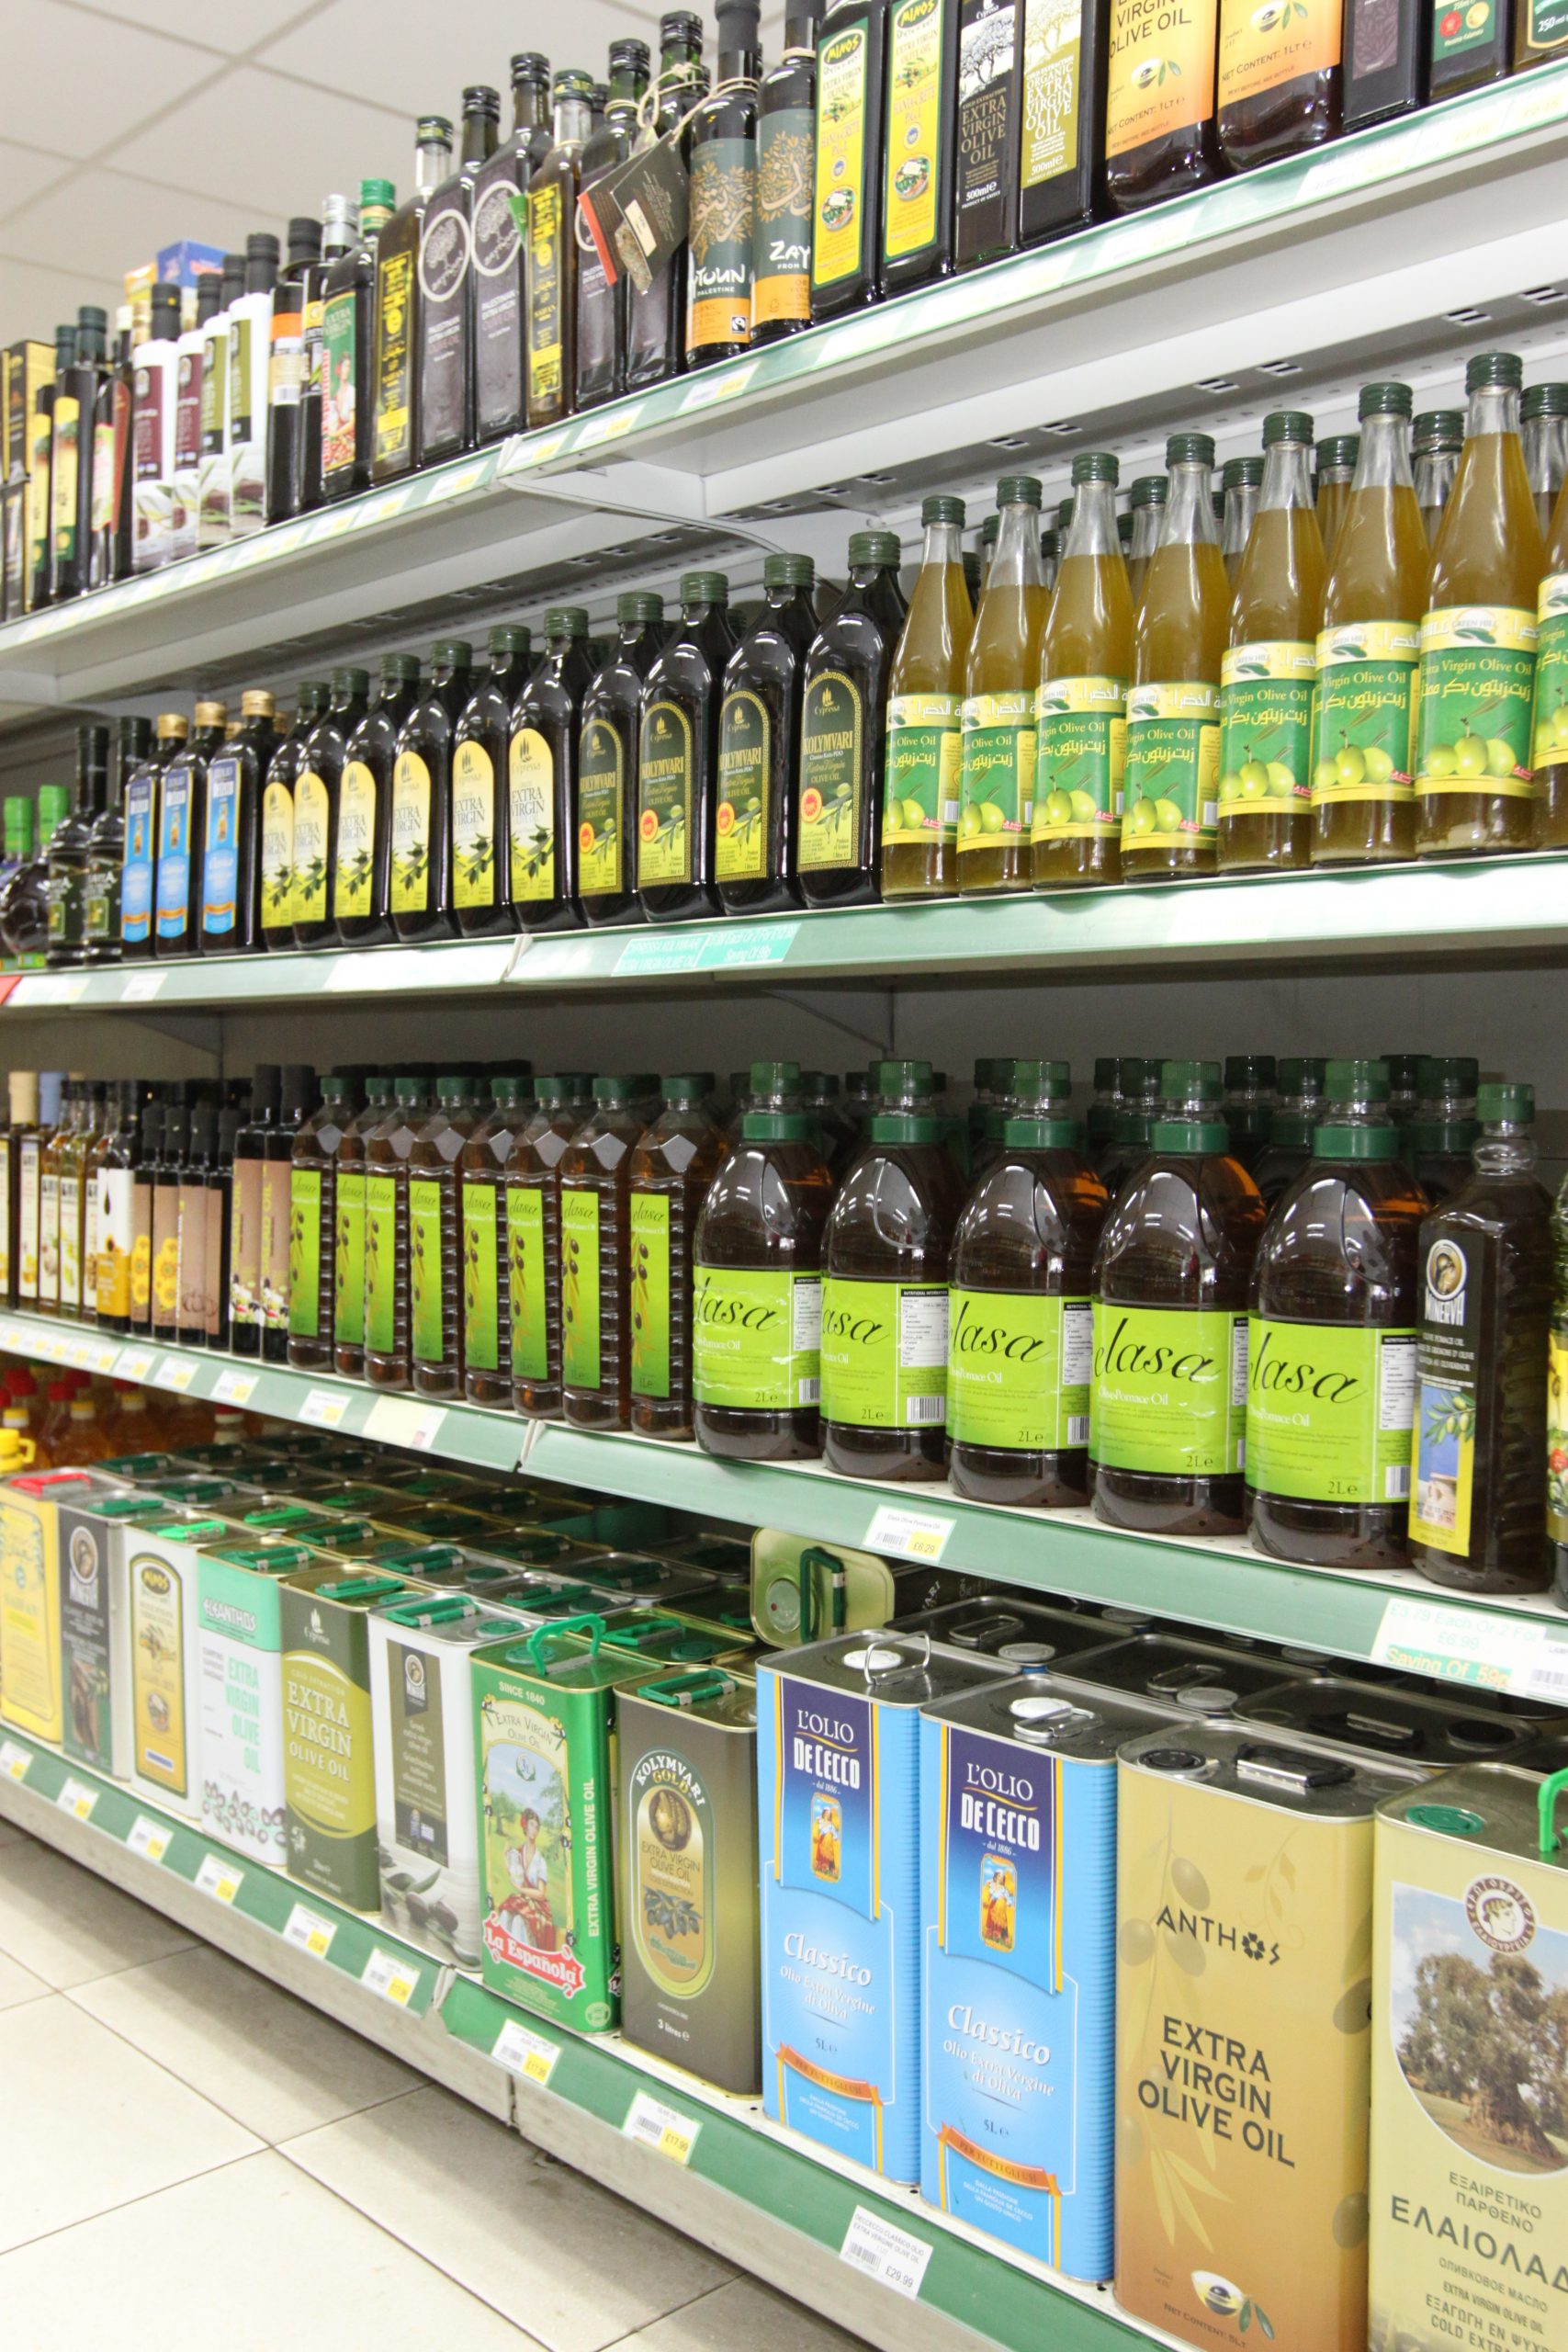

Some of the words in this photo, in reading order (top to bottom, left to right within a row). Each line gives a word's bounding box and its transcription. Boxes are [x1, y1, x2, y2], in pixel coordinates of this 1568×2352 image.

[1157, 8, 1191, 30] OIL
[1027, 62, 1073, 89] ORGANIC
[1027, 74, 1073, 103] EXTRA
[963, 95, 1007, 125] EXTRA
[1026, 87, 1072, 116] VIRGIN
[1026, 101, 1071, 130] OLIVE
[962, 109, 1006, 138] VIRGIN
[1035, 117, 1061, 140] OIL
[961, 124, 1006, 153] OLIVE
[970, 145, 996, 164] OIL
[696, 287, 735, 297] PALESTINE
[1323, 675, 1350, 689] Virgin
[1353, 672, 1384, 684] Olive
[1387, 671, 1406, 684] Oil
[1442, 660, 1475, 673] Virgin
[1480, 658, 1512, 672] Olive
[1515, 662, 1531, 675] Oil
[814, 705, 840, 718] Cypressa
[1229, 694, 1254, 707] Virgin
[1257, 689, 1287, 702] Olive
[1290, 689, 1307, 701] Oil
[803, 730, 853, 754] KOLYMVARI
[897, 736, 918, 748] Olive
[920, 734, 936, 745] Oil
[971, 738, 994, 749] Olive
[996, 735, 1012, 746] Oil
[1059, 722, 1086, 734] Olive
[1088, 721, 1105, 732] Oil
[1147, 729, 1174, 741] Olive
[1177, 728, 1195, 740] Oil
[641, 755, 684, 779] KOLYMVARI
[720, 746, 762, 770] KOLYMVARI
[455, 796, 483, 813] EXTRA
[511, 799, 545, 818] VIRGIN
[512, 786, 543, 804] EXTRA
[696, 1276, 783, 1331] lasa
[949, 1300, 1052, 1363] lasa
[987, 1372, 1002, 1384] Oil
[1248, 1331, 1368, 1404] lasa
[1150, 1393, 1168, 1406] Oil
[1292, 1412, 1310, 1427] Oil
[912, 1541, 935, 1555] £6.29
[1435, 1611, 1472, 1628] Each
[1498, 1623, 1509, 1637] 2
[1513, 1625, 1539, 1642] For
[229, 1657, 259, 1690] EXTRA
[1388, 1646, 1442, 1676] Saving
[1447, 1659, 1471, 1679] Of
[225, 1682, 260, 1718] VIRGIN
[288, 1680, 350, 1729] EXTRA
[499, 1680, 524, 1699] SINCE
[525, 1690, 546, 1706] 1840
[231, 1713, 260, 1746] OLIVE
[288, 1709, 352, 1759] VIRGIN
[495, 1712, 522, 1727] EXTRA
[524, 1716, 553, 1746] VIRGIN
[795, 1708, 855, 1745] L'OLIO
[243, 1747, 261, 1774] OIL
[289, 1741, 326, 1771] OLIVE
[329, 1759, 351, 1781] OIL
[582, 1778, 594, 1801] OIL
[635, 1755, 706, 1808] KOLYMVARI
[652, 1769, 688, 1794] GOLD
[966, 1762, 1034, 1802] L'OLIO
[584, 1802, 596, 1843] OLIVE
[641, 1840, 668, 1860] EXTRA
[670, 1850, 701, 1873] VIRGIN
[987, 1839, 997, 1850] dal
[998, 1841, 1012, 1856] 1886
[586, 1845, 597, 1890] VIRGIN
[649, 1856, 674, 1876] OLIVE
[676, 1866, 691, 1883] OIL
[588, 1892, 599, 1938] EXTRA
[485, 1929, 505, 1958] La
[506, 1936, 579, 1987] Española
[784, 1932, 873, 1987] Classico
[780, 1966, 802, 1984] Olio
[804, 1973, 832, 1997] Extra
[833, 1985, 875, 2017] Vergine
[805, 1993, 815, 2004] di
[816, 1996, 849, 2021] Oliva
[657, 2017, 664, 2030] 3
[665, 2021, 682, 2039] litres
[947, 2004, 1051, 2066] Classico
[1163, 2015, 1272, 2083] EXTRA
[943, 2040, 968, 2060] Olio
[970, 2048, 1004, 2076] Extra
[1005, 2063, 1055, 2097] Vergine
[972, 2070, 985, 2084] di
[986, 2075, 1022, 2102] Oliva
[1160, 2050, 1271, 2120] VIRGIN
[1137, 2078, 1233, 2141] OLIVE
[1242, 2120, 1295, 2169] OIL
[959, 2141, 975, 2155] PER
[1449, 2171, 1542, 2220] ΕΞΑΙΡΕΤΙΚΟ
[1456, 2191, 1534, 2234] ΠΑΡΘΕΝΟ
[884, 2229, 911, 2249] CLASSICO
[910, 2245, 924, 2257] OLIO
[885, 2265, 913, 2288] £29.99
[1438, 2256, 1506, 2295] ОЛИВКОВОЕ
[1508, 2287, 1549, 2314] МАСЛО
[1164, 2301, 1182, 2316] NET
[1426, 2293, 1483, 2332] ΕΞΑΓΩΓΗ
[1488, 2322, 1506, 2342] ΕΝ
[1443, 2279, 1470, 2302] EXTRA
[1471, 2293, 1502, 2316] VIRGIN
[1502, 2307, 1529, 2329] OLIVE
[1529, 2320, 1545, 2335] OIL
[1431, 2314, 1464, 2340] COLD
